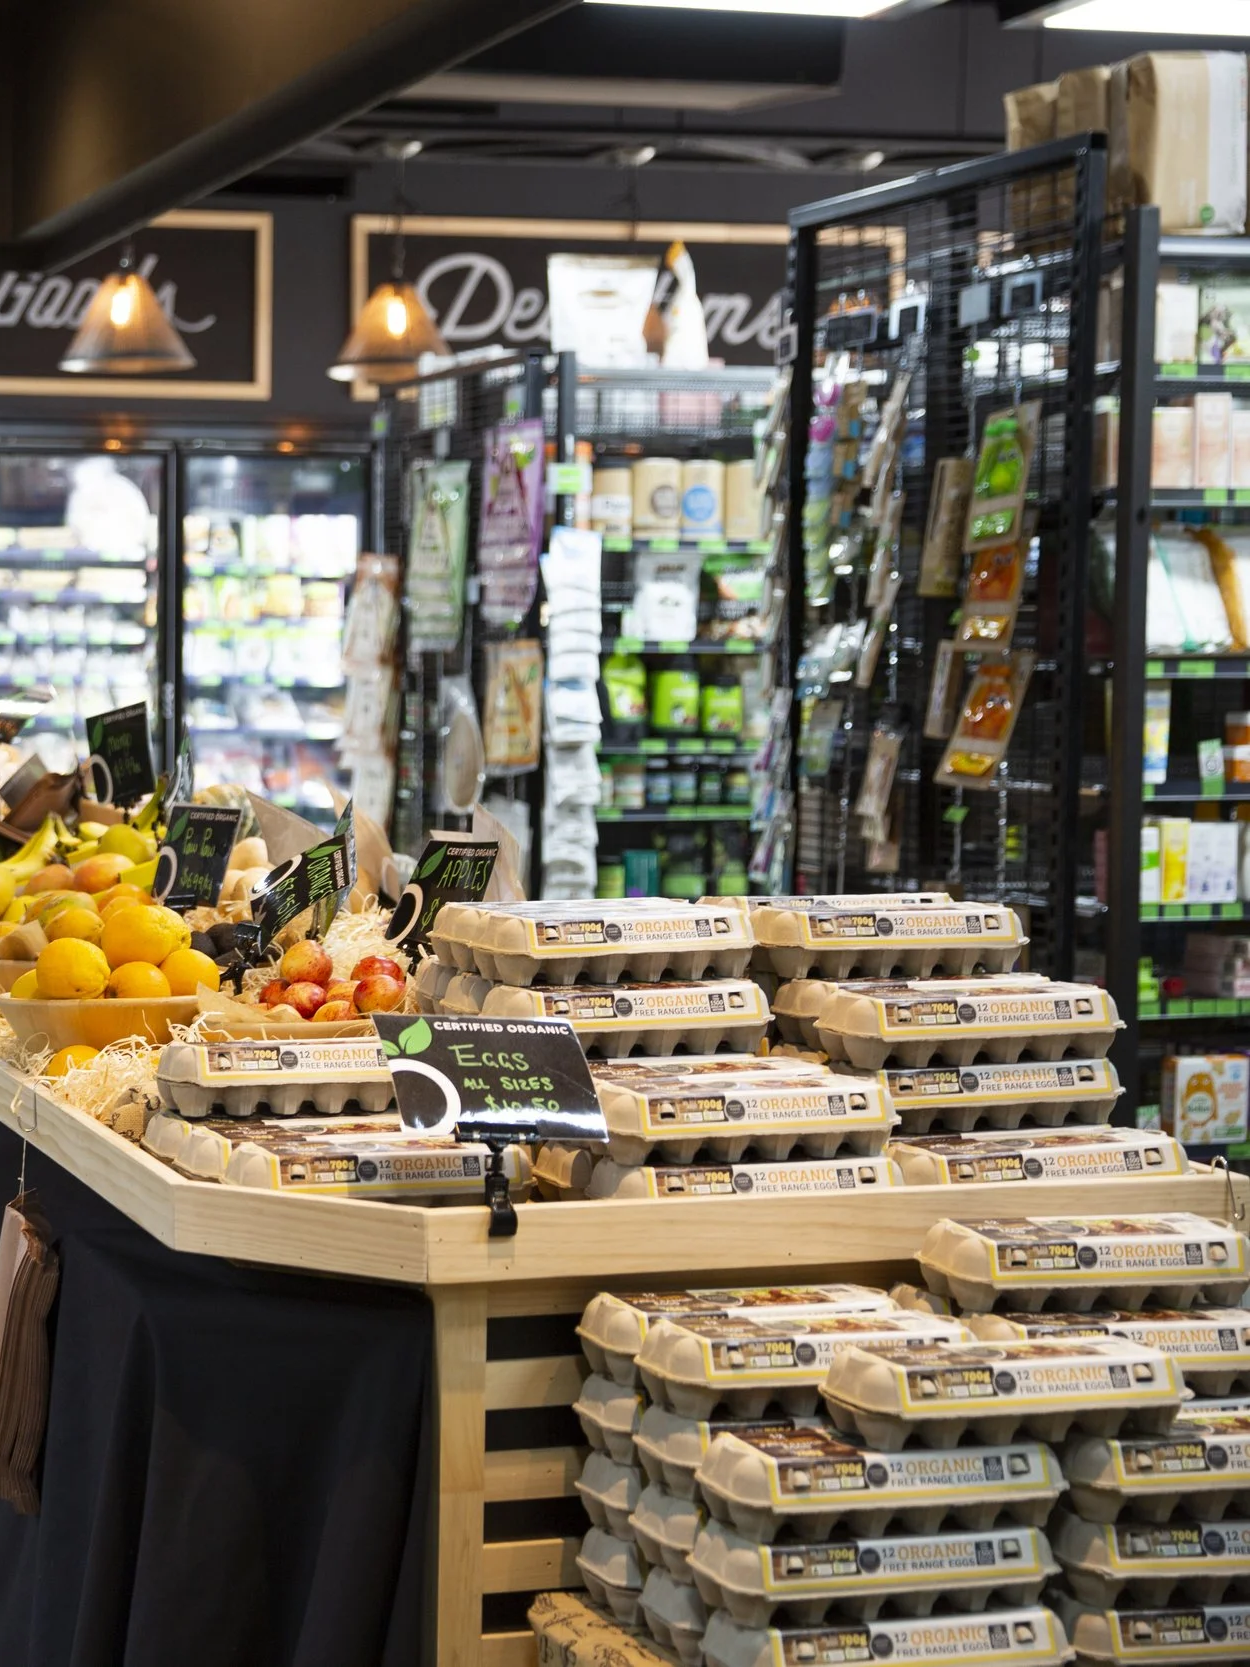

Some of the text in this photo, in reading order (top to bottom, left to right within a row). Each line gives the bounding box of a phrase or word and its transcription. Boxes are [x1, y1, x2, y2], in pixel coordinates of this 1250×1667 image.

[447, 847, 498, 857] CERTIFIED ORGANIC
[436, 859, 491, 891] APPLES
[622, 919, 694, 933] 12 ORGANIC
[851, 917, 874, 927] 700g
[894, 916, 965, 927] 12 ORGANIC
[579, 923, 602, 933] 700g
[895, 928, 915, 936] FREE
[646, 932, 673, 940] RANGE
[676, 931, 696, 939] EGGS
[589, 997, 612, 1008] 700g
[633, 994, 707, 1007] 12 ORGANIC
[635, 1006, 709, 1016] FREE RANGE EGGS
[931, 1003, 955, 1014] 700g
[977, 1001, 1053, 1014] 12 ORGANIC
[978, 1013, 1055, 1023] FREE RANGE EGGS
[433, 1021, 570, 1035] CERTIFIED ORGANIC
[254, 1050, 278, 1060] 700g
[299, 1049, 375, 1061] 12 ORGANIC
[355, 1060, 376, 1068] EGGS
[934, 1073, 958, 1083] 700g
[979, 1068, 1056, 1082] 12 ORGANIC
[463, 1076, 555, 1092] ALL SIZES
[981, 1083, 1002, 1091] FREE
[1004, 1081, 1033, 1089] RANGE
[697, 1099, 723, 1111] 700g
[746, 1095, 827, 1110] 12 ORGANIC
[747, 1108, 829, 1120] FREE RANGE EGGS
[379, 1156, 461, 1171] 12 ORGANIC
[995, 1158, 1021, 1169] 700g
[1043, 1151, 1123, 1168] 12 ORGANIC
[329, 1160, 355, 1171] 700g
[1045, 1164, 1125, 1177] FREE RANGE EGGS
[380, 1170, 462, 1181] FREE RANGE EGGS
[705, 1172, 731, 1183] 700g
[754, 1169, 836, 1183] 12 ORGANIC
[755, 1181, 838, 1192] FREE RANGE EGGS
[1048, 1246, 1074, 1258] 700g
[1099, 1244, 1183, 1258] 12 ORGANIC
[1100, 1258, 1185, 1268] FREE RANGE EGGS
[1132, 1329, 1218, 1344] 12 ORGANIC
[765, 1342, 792, 1355] 700g
[818, 1342, 830, 1352] 12
[1195, 1343, 1219, 1352] EGGS
[1229, 1444, 1242, 1454] 12
[1231, 1460, 1250, 1469] FRE
[1226, 1531, 1239, 1541] 12
[1229, 1616, 1242, 1626] 12
[1230, 1631, 1250, 1640] FRE
